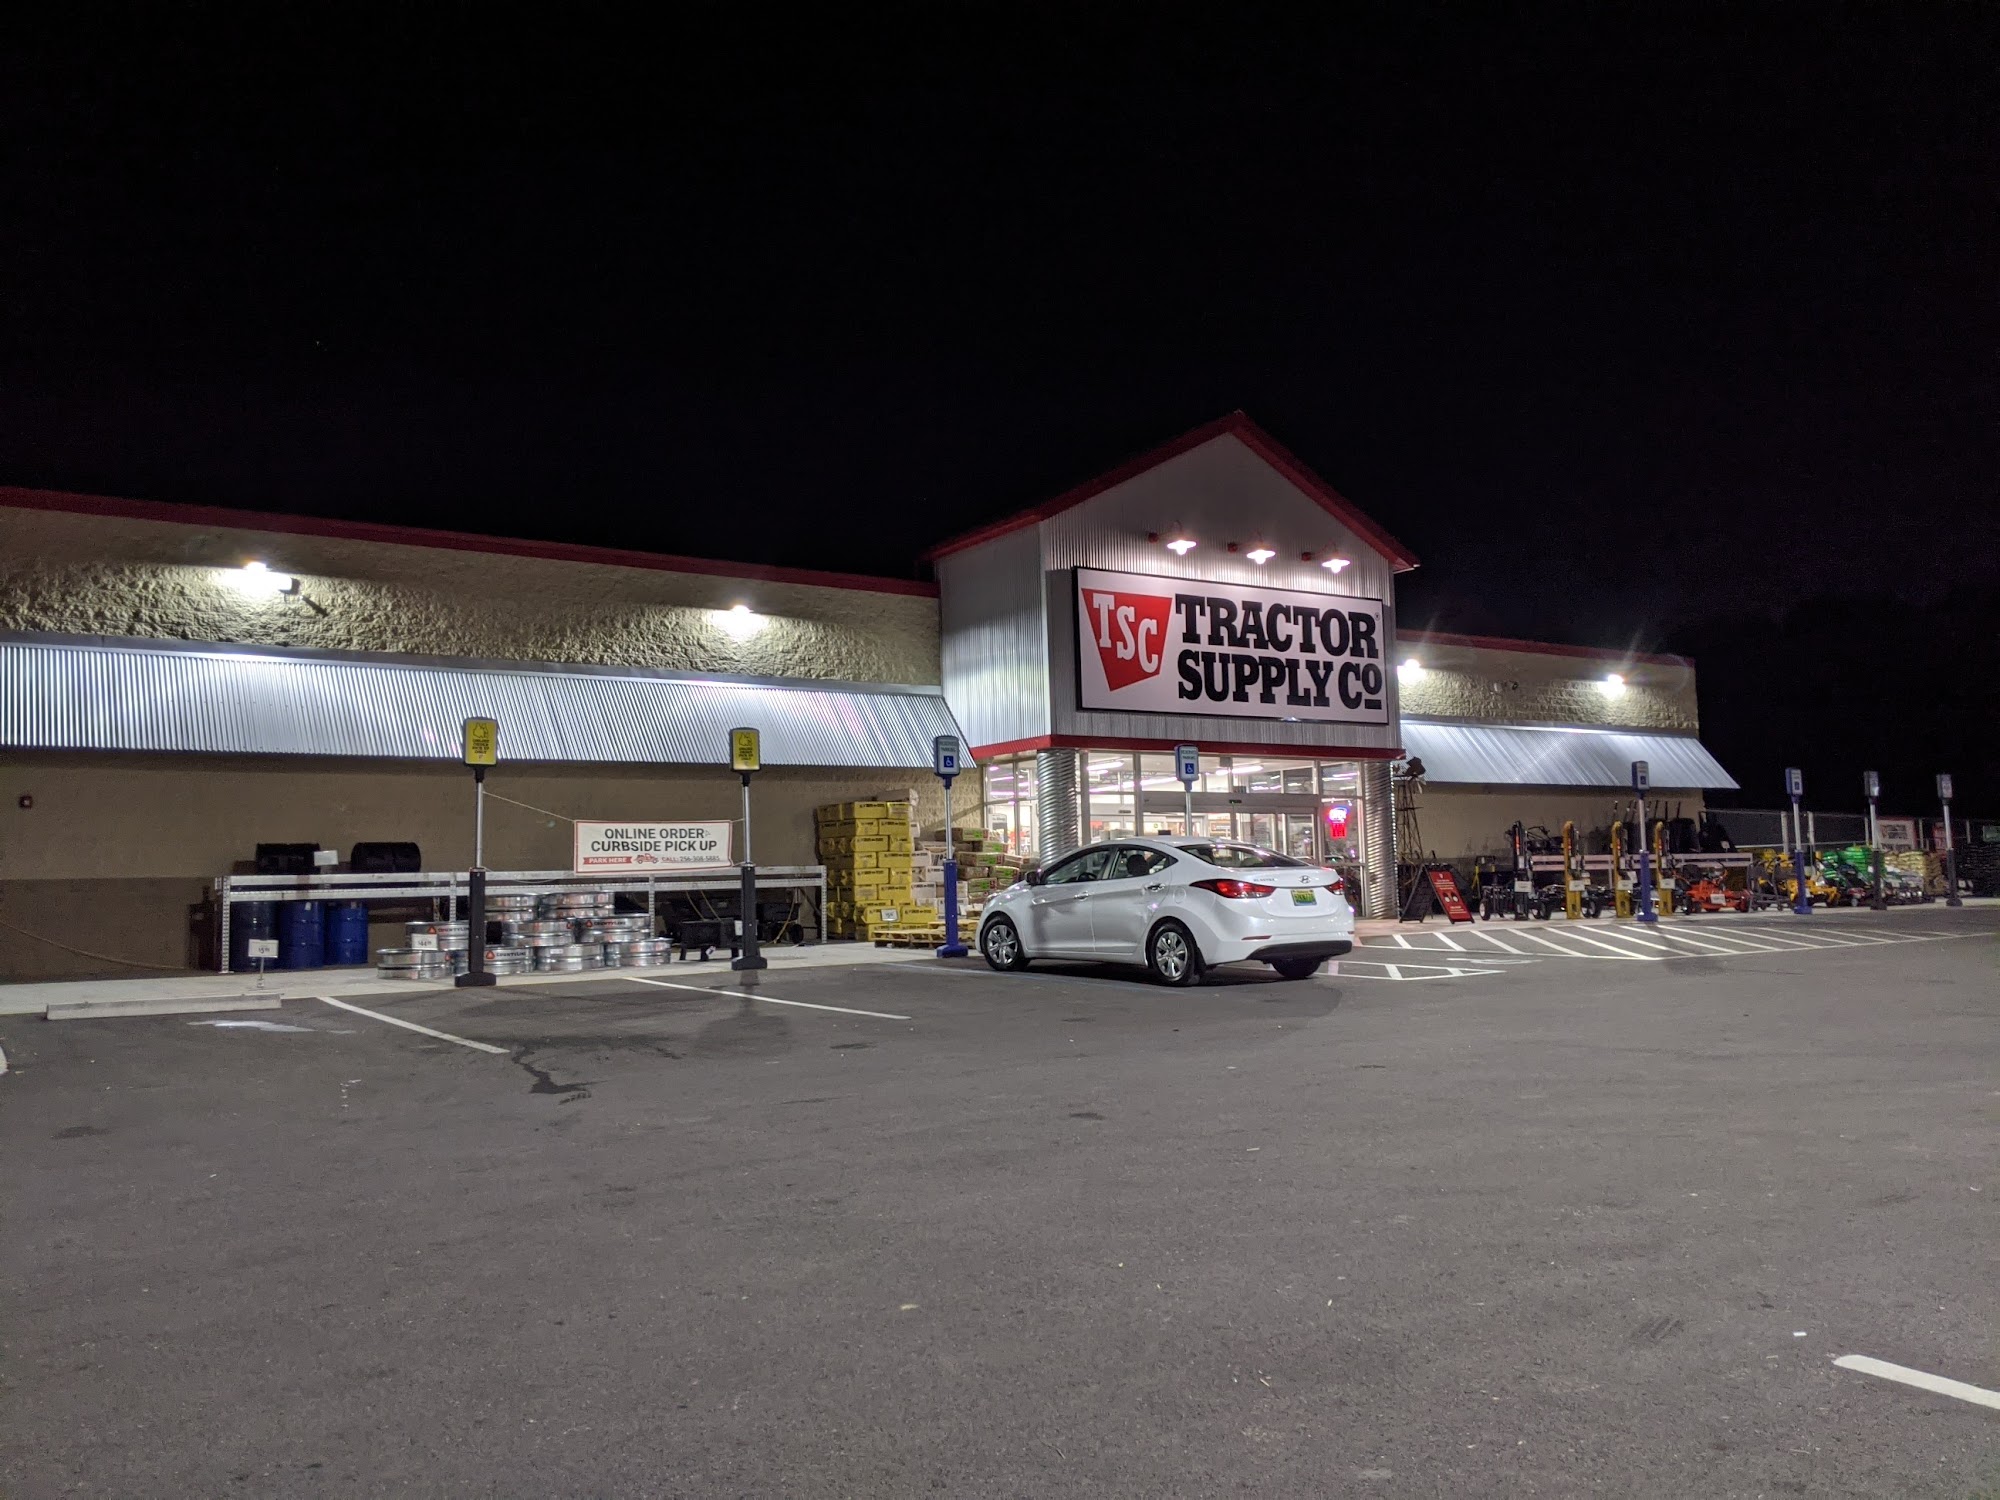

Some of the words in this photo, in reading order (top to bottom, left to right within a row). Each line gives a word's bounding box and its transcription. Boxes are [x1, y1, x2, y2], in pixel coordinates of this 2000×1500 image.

[1093, 592, 1159, 674] TSC
[1175, 593, 1380, 659] TRACTOR
[1177, 649, 1334, 708] SUPPLY
[591, 840, 662, 852] CURBSIDE
[664, 840, 697, 852] PICK
[699, 840, 717, 851] UP
[604, 828, 657, 840] ONLINE
[659, 828, 705, 839] ORDER
[608, 856, 627, 864] HERE
